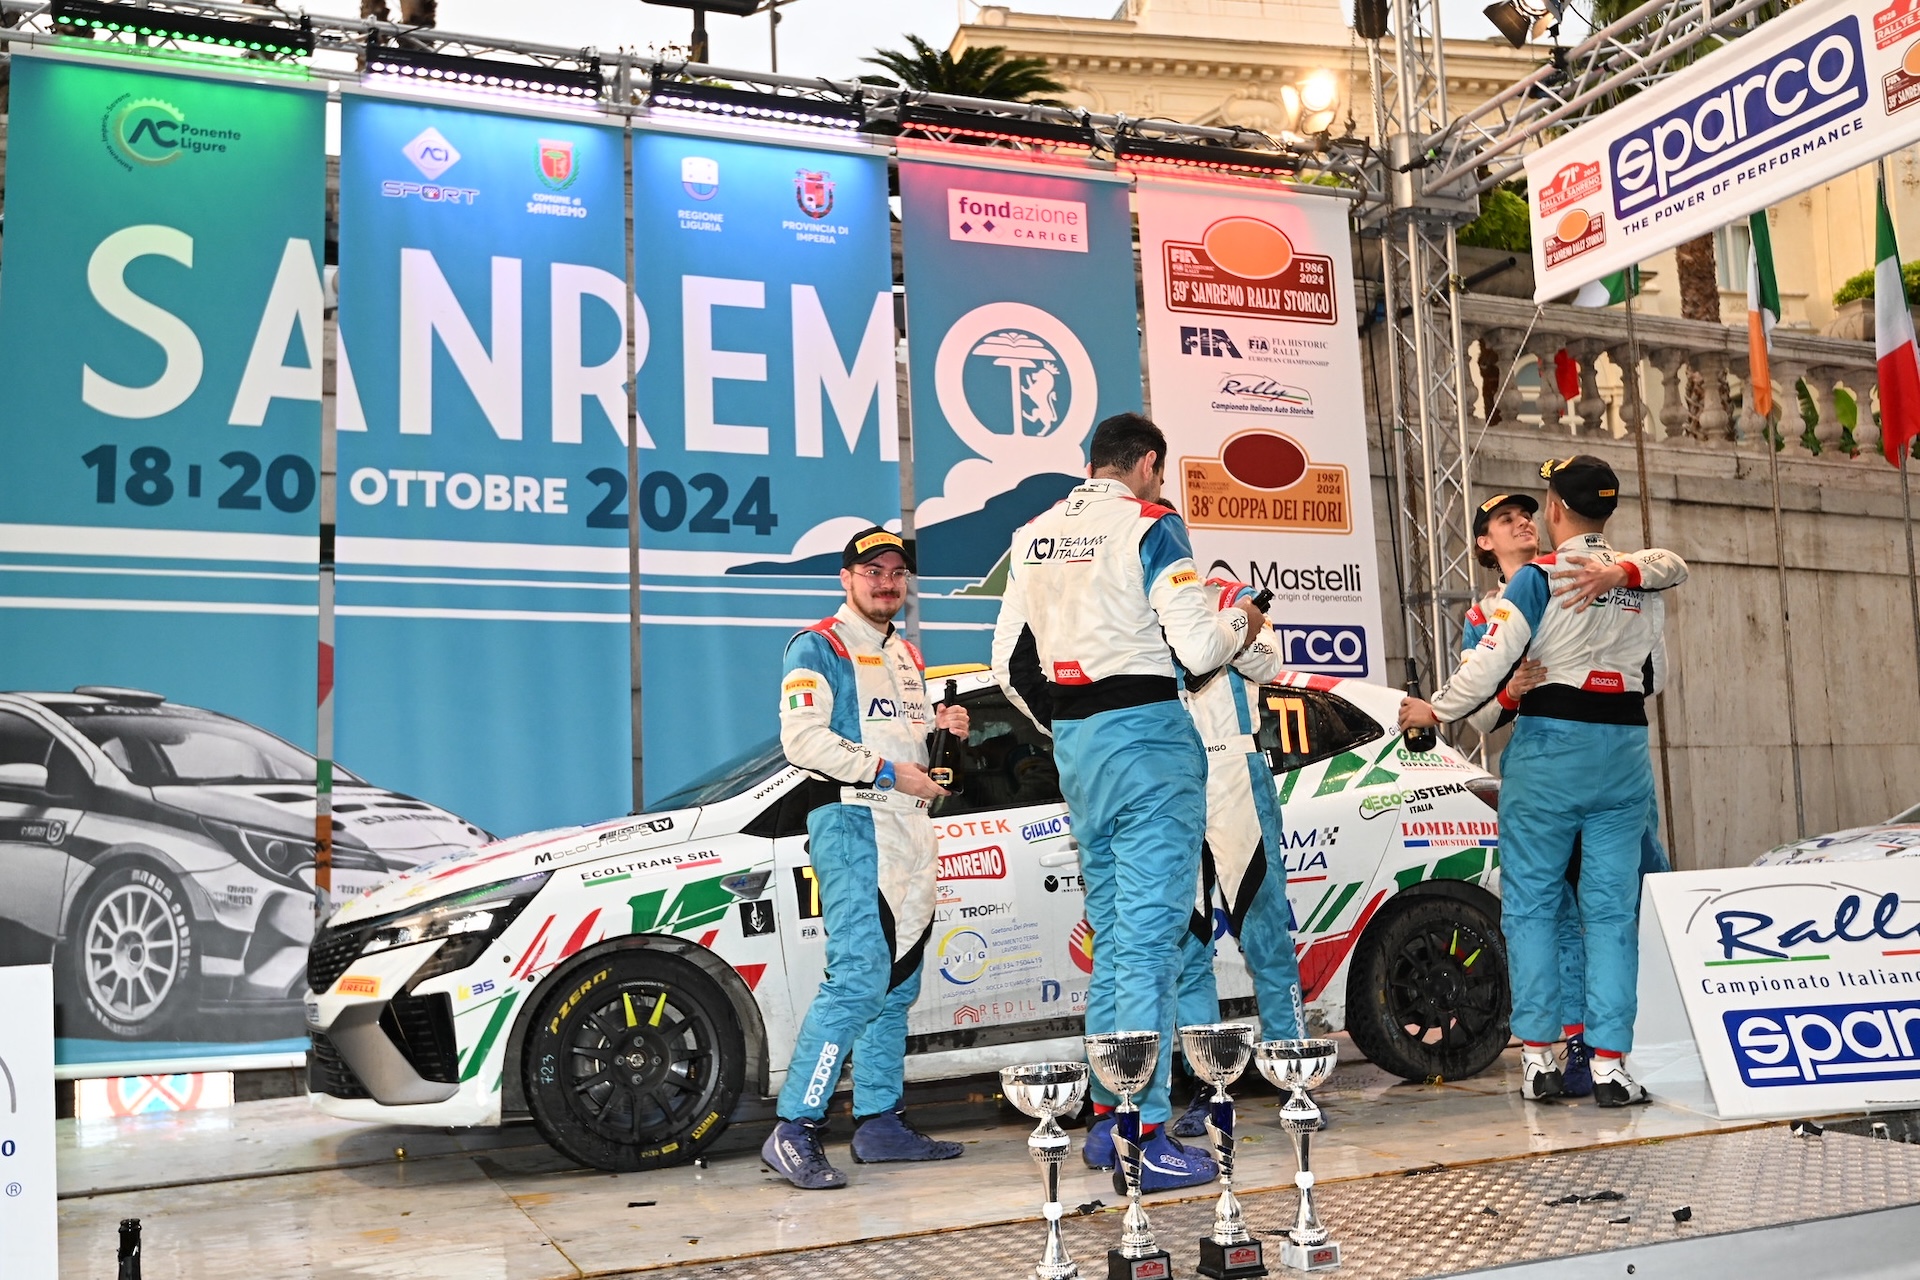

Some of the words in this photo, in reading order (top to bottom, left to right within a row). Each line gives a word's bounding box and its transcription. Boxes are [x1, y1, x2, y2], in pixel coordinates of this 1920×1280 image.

[1877, 14, 1914, 40] RALLYE
[1616, 34, 1855, 197] sparco
[181, 123, 241, 140] Ponente
[181, 137, 227, 153] Ligure
[1622, 217, 1649, 237] THE
[1655, 191, 1705, 222] POWER
[1712, 178, 1731, 196] OF
[1737, 117, 1864, 185] PERFORMANCE
[381, 181, 479, 205] SPORT
[532, 193, 571, 205] COMUNE
[526, 202, 588, 218] SANREMO
[678, 209, 724, 223] REGIONE
[958, 196, 1079, 226] fondazione
[680, 220, 722, 232] LIGURIA
[782, 220, 836, 234] PROVINCIA
[837, 225, 849, 235] DI
[796, 232, 836, 245] IMPERIA
[1013, 229, 1079, 244] CARIGE
[1299, 262, 1324, 273] 1986
[1299, 273, 1325, 285] 2024
[1191, 282, 1245, 307] SANREMO
[1247, 286, 1281, 310] RALLY
[1283, 289, 1330, 314] STORICO
[1180, 325, 1243, 359] FIA
[1272, 338, 1287, 346] FIA
[1288, 339, 1328, 350] HISTORIC
[1272, 348, 1300, 357] RALLY
[1248, 356, 1282, 364] EUROPEAN
[1283, 358, 1330, 367] CHAMPIONSHIP
[1220, 380, 1289, 402] Rally
[1212, 401, 1249, 412] Campionato
[1250, 403, 1273, 413] Italiano
[1274, 406, 1289, 414] Auto
[1289, 407, 1314, 415] Storiche
[1316, 473, 1340, 483] 1987
[82, 445, 174, 505] 18
[217, 450, 316, 513] 20
[350, 467, 569, 515] OTTOBRE
[586, 467, 778, 536] 2024
[1316, 484, 1341, 494] 2024
[1218, 496, 1268, 519] COPPA
[1272, 499, 1298, 521] DEI
[1302, 501, 1342, 522] FIORI
[1058, 536, 1096, 548] TEAM
[1053, 547, 1095, 559] ITALIA
[1250, 561, 1361, 592] Mastelli
[1278, 591, 1300, 603] origin
[1301, 591, 1310, 601] of
[1311, 593, 1363, 604] regeneration
[1276, 628, 1362, 664] rco
[1409, 802, 1434, 814] ITALIA
[1430, 839, 1479, 847] INDUSTRIAL
[580, 854, 683, 881] ECOLTRANS
[688, 850, 720, 862] SRL
[937, 849, 1002, 878] SANREMO
[959, 902, 1013, 918] TROPHY
[1714, 892, 1920, 960] Rall
[339, 978, 376, 994] PIRELLI
[472, 980, 495, 995] 35
[1701, 973, 1830, 996] Campionato
[1737, 1008, 1920, 1081] spar
[808, 1042, 840, 1108] sparco
